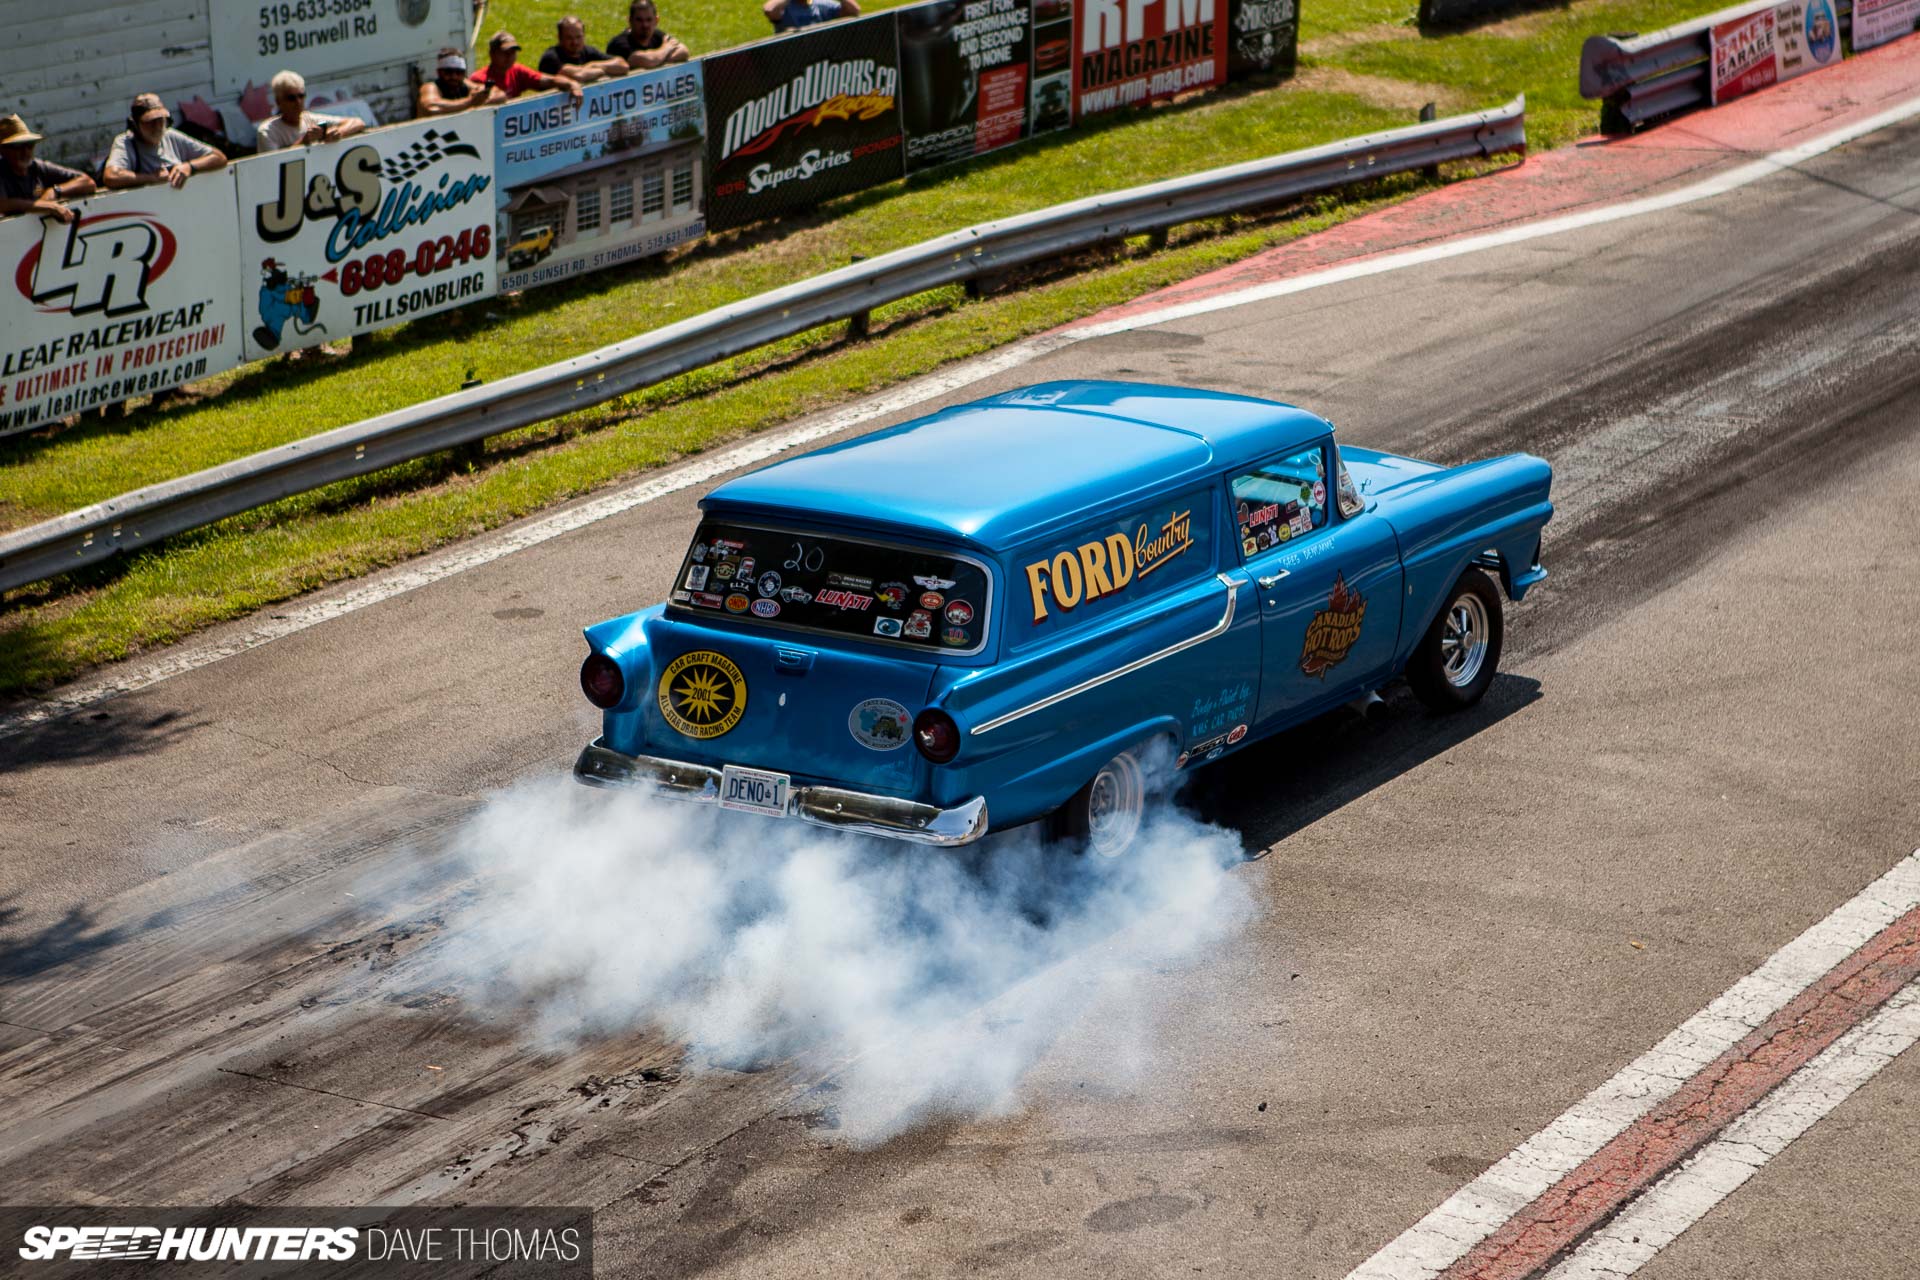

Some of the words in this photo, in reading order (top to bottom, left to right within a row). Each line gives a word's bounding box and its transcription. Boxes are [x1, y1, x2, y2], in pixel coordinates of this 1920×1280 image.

[953, 8, 1029, 41] PERFORMANCE
[965, 1, 991, 21] FIRST
[258, 34, 279, 56] 39
[284, 19, 349, 51] Burwell
[354, 14, 377, 37] Rd
[959, 38, 979, 58] AND
[980, 27, 1023, 51] SECOND
[1717, 32, 1774, 77] GARAGE
[969, 54, 981, 70] TO
[983, 45, 1012, 66] NONE
[1081, 24, 1214, 89] MAGAZINE
[504, 102, 581, 138] SUNSET
[588, 88, 637, 119] AUTO
[642, 74, 696, 105] SALES
[506, 147, 536, 165] FULL
[540, 135, 587, 157] SERVICE
[590, 129, 618, 146] AUTO
[623, 116, 658, 137] REPAIR
[256, 144, 382, 243] J&S
[325, 172, 491, 263] Collision
[340, 224, 491, 297] 688-0246
[502, 272, 529, 290] 6500
[532, 263, 570, 283] SUNSET
[353, 272, 484, 327] TILLSONBURG
[2, 337, 64, 377] LEAF
[66, 302, 205, 359] RACEWEAR
[15, 361, 89, 402] ULTIMATE
[95, 354, 114, 378] IN
[121, 323, 226, 371] PROTECTION!
[0, 357, 208, 431] www.leafracewear.com
[1249, 503, 1279, 528] LUNATI
[784, 541, 824, 572] 20
[1025, 532, 1135, 625] FORD
[1133, 509, 1193, 570] Country
[755, 602, 776, 615] NHRA
[815, 588, 873, 611] LUNATI
[1303, 627, 1330, 657] HOT
[1327, 623, 1361, 651] RODS
[1306, 601, 1367, 639] CANADIAN
[670, 658, 686, 674] CAR
[686, 653, 710, 665] CRAFT
[711, 655, 743, 685] MAGAZINE
[691, 687, 712, 702] 2001
[660, 694, 682, 728] ALL-STAR
[681, 722, 698, 735] DRAG
[699, 722, 725, 736] RACING
[724, 706, 742, 727] TEAM
[729, 778, 765, 802] DENO
[773, 784, 779, 806] 1
